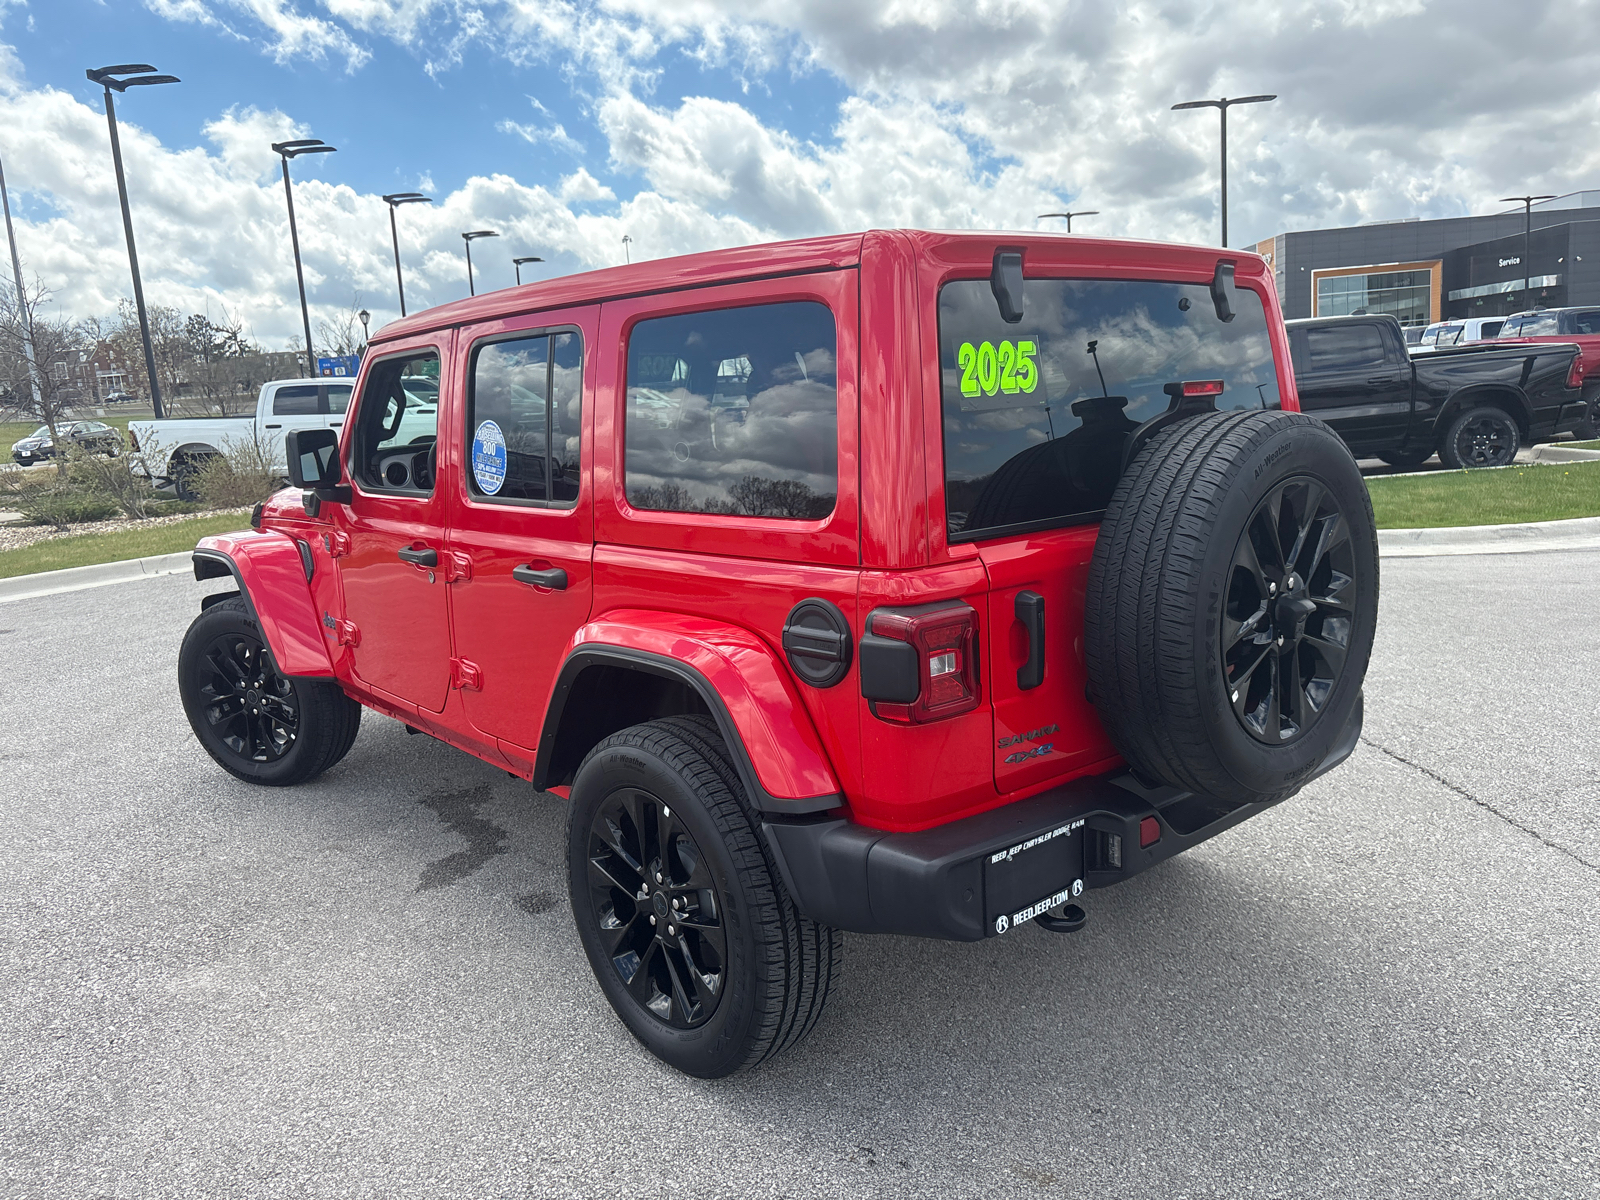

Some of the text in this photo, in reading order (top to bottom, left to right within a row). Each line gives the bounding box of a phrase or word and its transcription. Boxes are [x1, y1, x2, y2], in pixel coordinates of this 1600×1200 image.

[1498, 256, 1520, 267] Service
[958, 340, 1038, 398] 2025
[476, 452, 502, 467] MILE RANGE
[482, 440, 496, 456] 800
[1254, 442, 1292, 481] All-Weather
[998, 724, 1060, 748] SAHARA
[610, 754, 646, 768] All-Weather
[992, 819, 1084, 864] REED JEEP CHRYSLER DODGE RAM
[1013, 890, 1068, 926] REEDJEEP.COM
